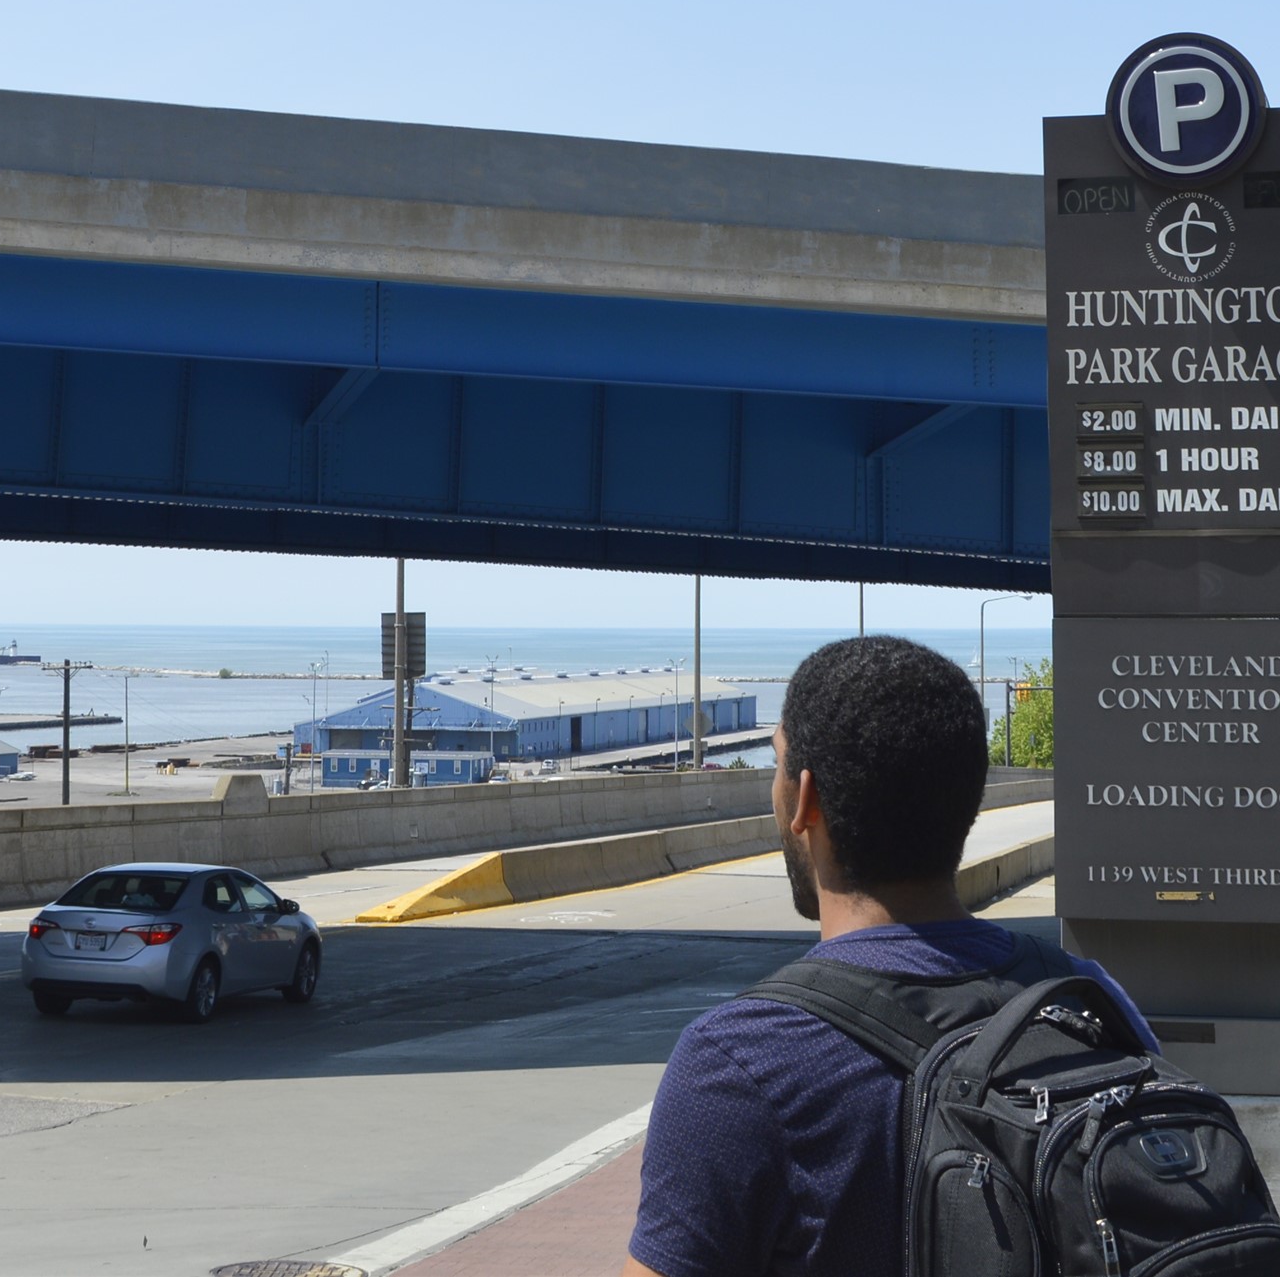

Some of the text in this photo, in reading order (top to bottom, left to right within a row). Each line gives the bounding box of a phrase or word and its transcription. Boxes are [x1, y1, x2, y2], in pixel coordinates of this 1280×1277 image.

[1153, 67, 1225, 153] P
[1064, 185, 1130, 212] OPEN
[1145, 192, 1236, 233] CUYAHOGA COUNTY OF OHIO
[1145, 242, 1236, 283] CUYAHOGA COUNTY OF OHIO
[1065, 346, 1162, 385] PARK
[1081, 409, 1137, 432] $2.00
[1154, 407, 1221, 432] MIN.
[1083, 447, 1260, 472] $8.00 1 HOUR
[1082, 490, 1140, 512] $10.00
[1156, 488, 1229, 513] MAX.
[1141, 721, 1261, 744] CENTER
[1086, 784, 1224, 808] LOADING
[1087, 865, 1134, 882] 1139
[1140, 866, 1203, 885] WEST
